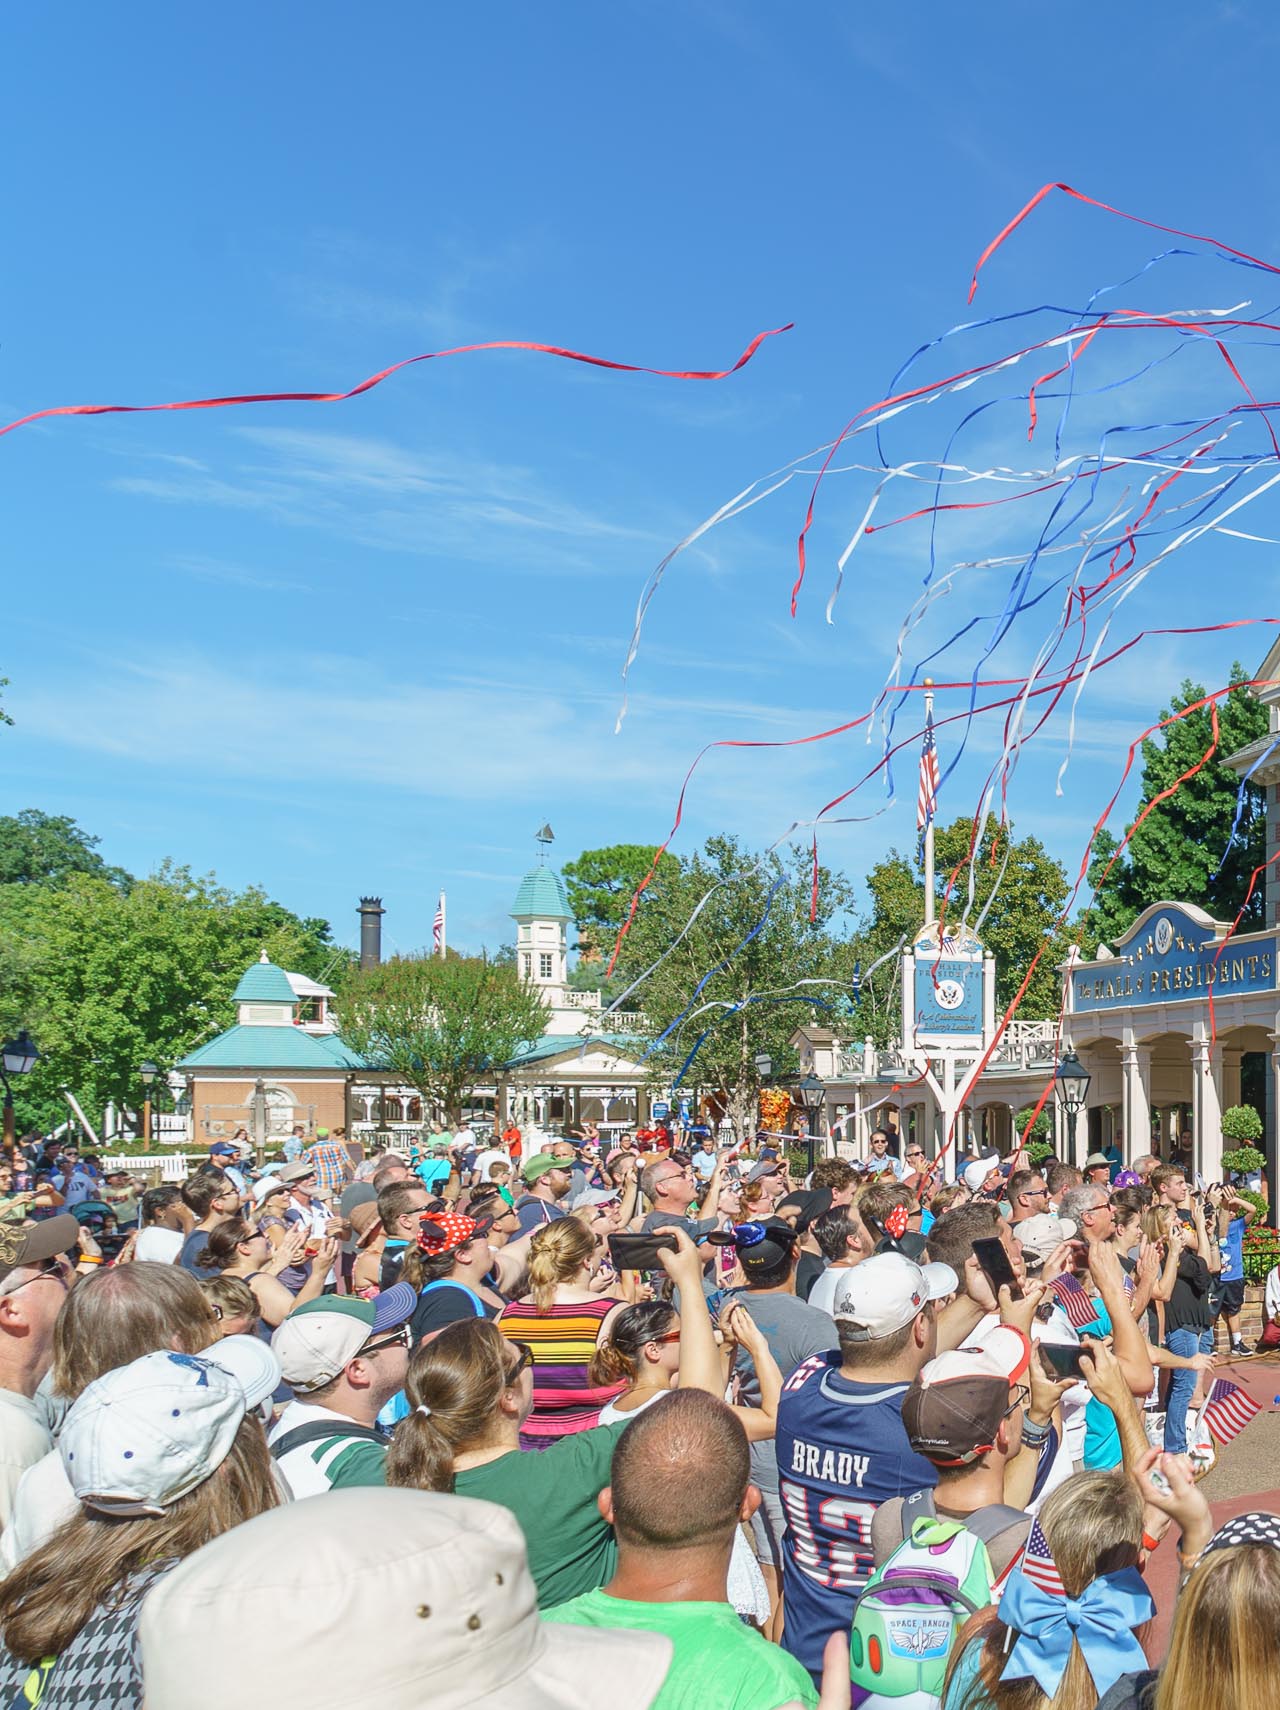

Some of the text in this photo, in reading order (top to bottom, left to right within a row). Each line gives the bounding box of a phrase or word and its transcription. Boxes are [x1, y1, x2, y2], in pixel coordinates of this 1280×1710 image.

[919, 970, 980, 978] PRSIDETS
[1094, 975, 1134, 999] HALL
[1150, 954, 1272, 992] PRESIDENTS
[791, 1439, 870, 1488] BRADY
[781, 1480, 878, 1588] 12
[890, 1619, 950, 1628] SPACE RANGER
